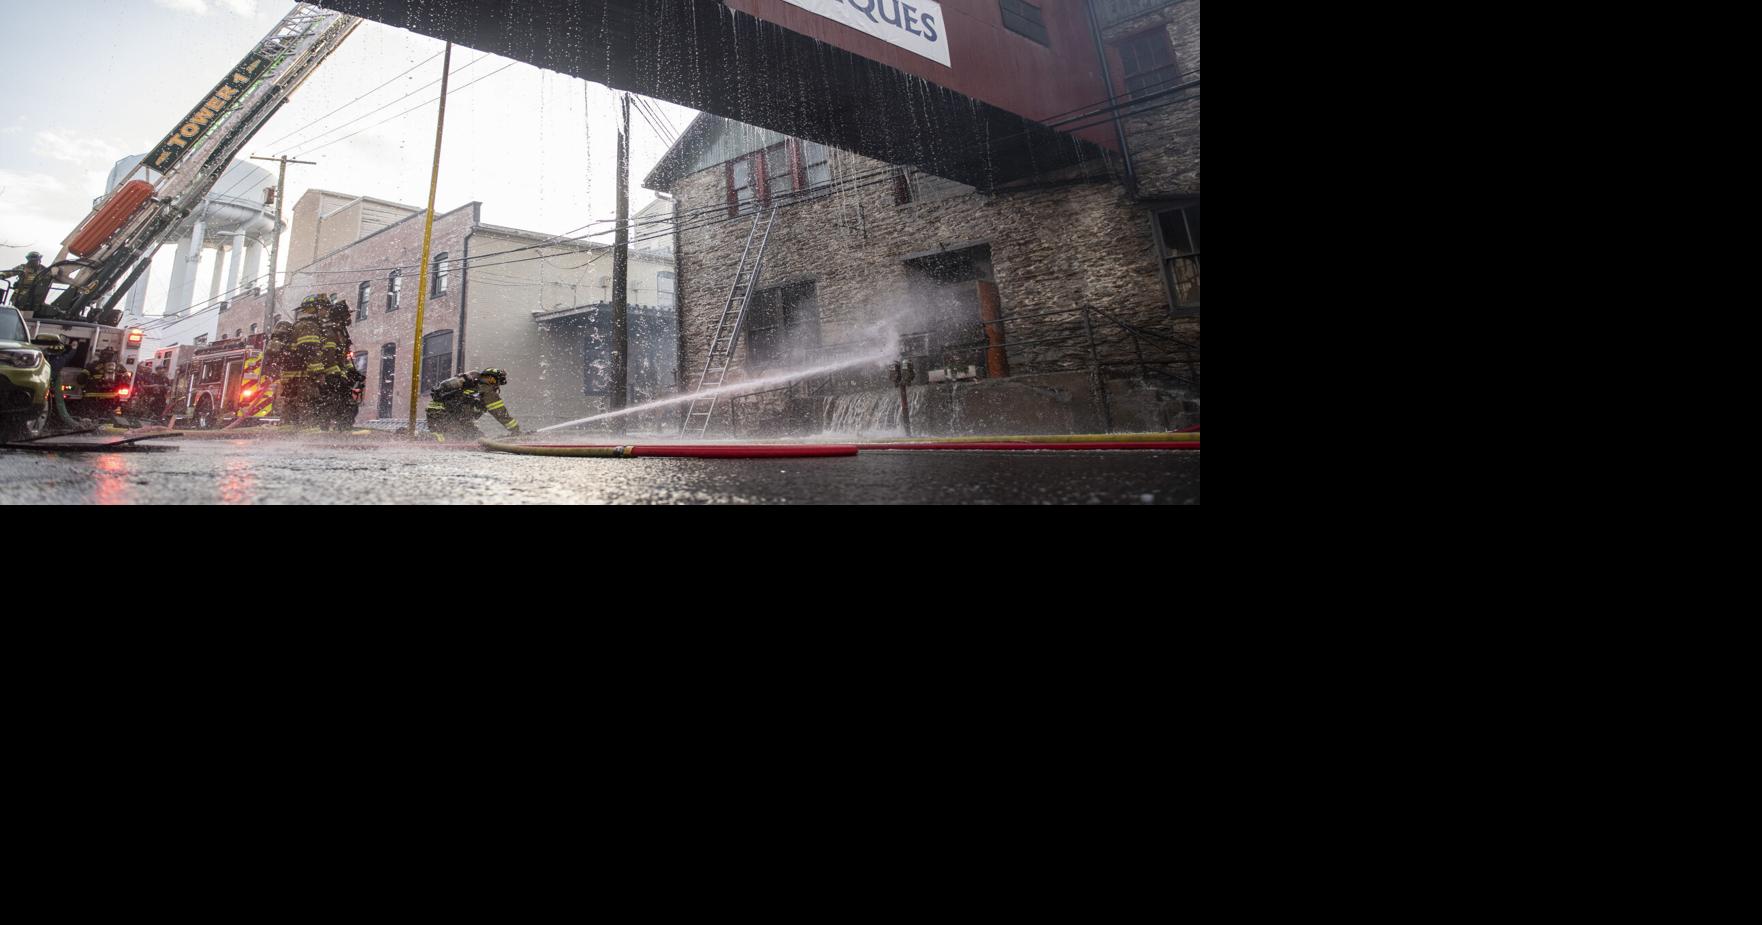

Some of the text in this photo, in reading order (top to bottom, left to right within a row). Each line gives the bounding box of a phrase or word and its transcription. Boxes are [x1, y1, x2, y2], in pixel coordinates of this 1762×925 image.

[836, 0, 938, 42] QUES
[167, 73, 249, 148] TOWER 1
